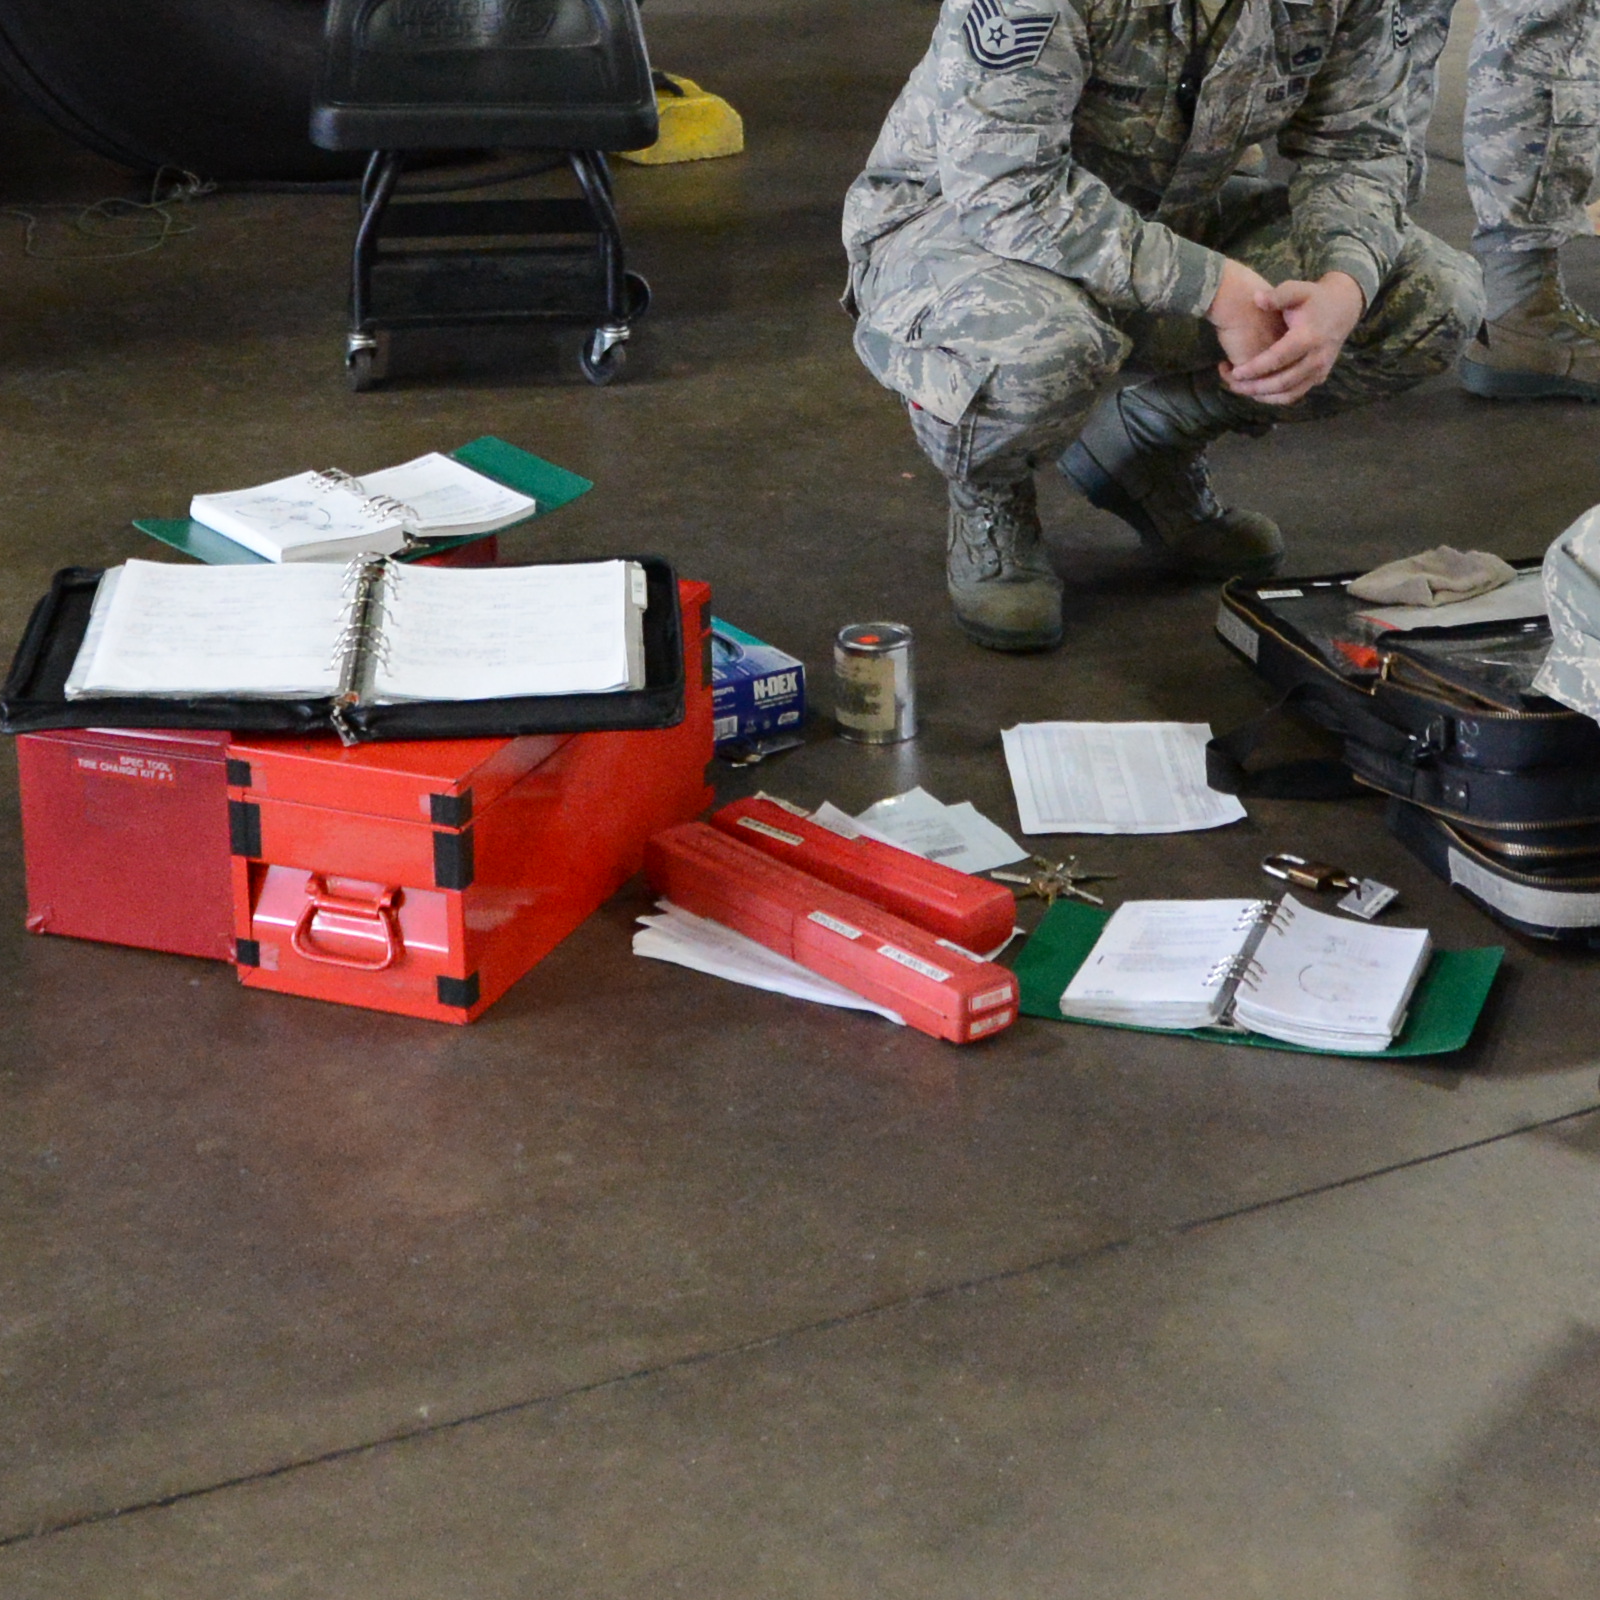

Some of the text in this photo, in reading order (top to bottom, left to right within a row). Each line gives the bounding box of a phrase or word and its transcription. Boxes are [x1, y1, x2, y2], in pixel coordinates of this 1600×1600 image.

[753, 671, 799, 700] N-DEX
[78, 758, 98, 770] TIRE
[100, 761, 138, 777] CHANGE
[140, 768, 155, 779] KIT
[120, 756, 171, 773] SPEC TOOL
